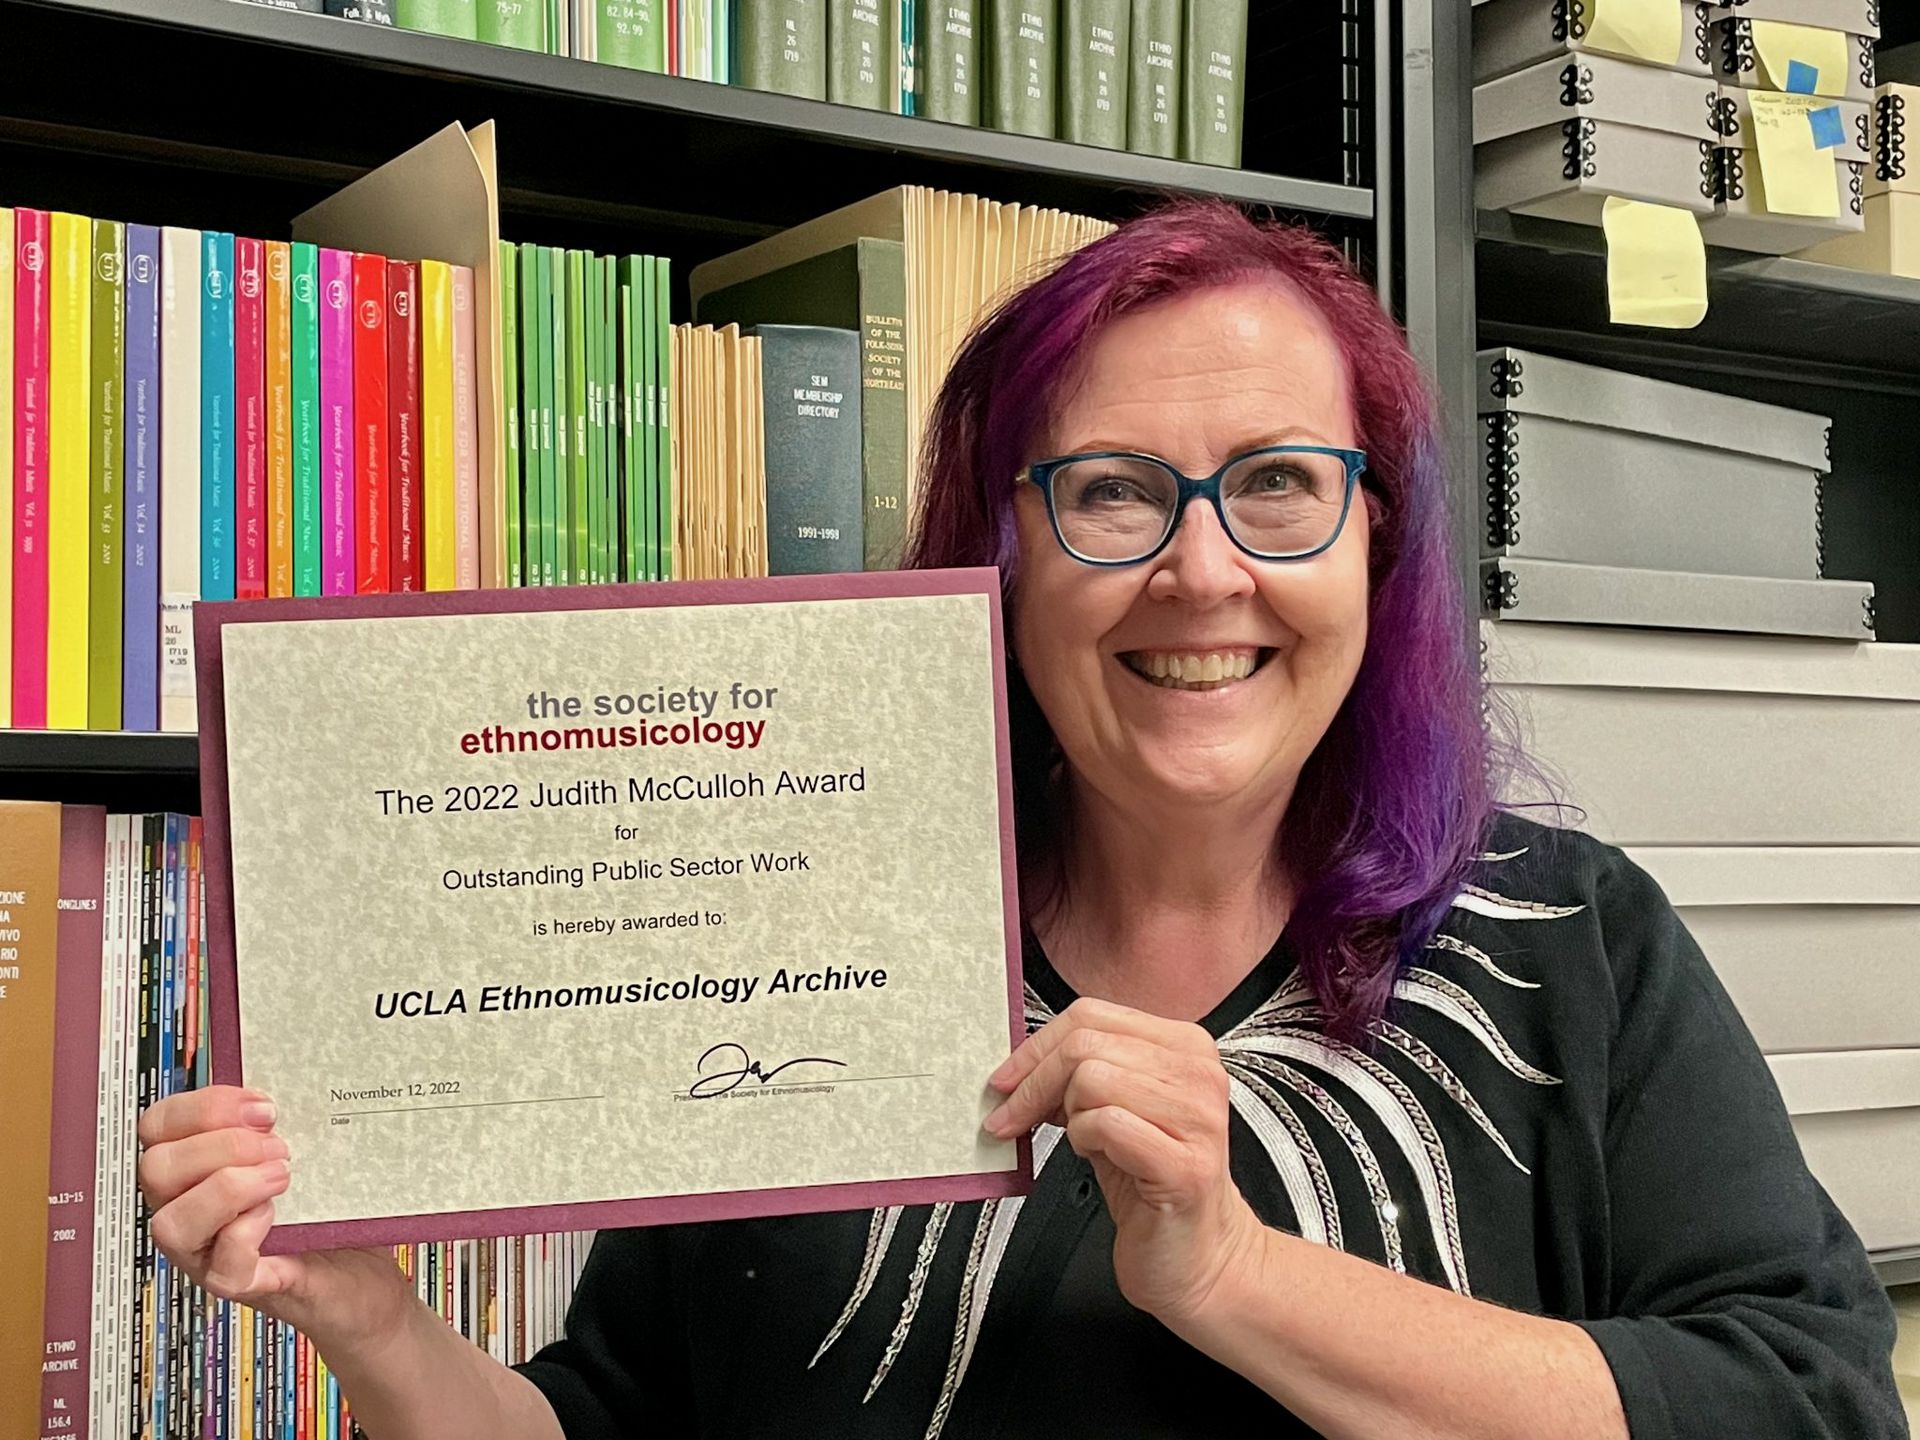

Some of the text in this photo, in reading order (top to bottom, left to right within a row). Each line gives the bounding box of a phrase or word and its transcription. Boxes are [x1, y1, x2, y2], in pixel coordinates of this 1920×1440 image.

[949, 7, 970, 23] ETHNO
[1022, 12, 1043, 28] ETHNO
[1092, 26, 1114, 41] ETHNO
[1150, 41, 1172, 55] ETHNO
[1211, 51, 1232, 66] ETHNO
[866, 315, 903, 327] BULLETIN
[871, 328, 901, 339] OF THE
[868, 353, 901, 365] SOCIETY
[811, 375, 829, 386] SEM
[872, 367, 901, 378] OF THE
[793, 389, 843, 404] MEMBERSHIP
[797, 405, 840, 419] DIRECTORY
[301, 400, 311, 445] Yearbook
[333, 405, 343, 449] Yearbook
[273, 434, 285, 451] for
[400, 412, 409, 456] Yearbook
[103, 428, 113, 468] Traditional
[137, 428, 146, 468] Traditional
[300, 447, 312, 462] for
[332, 451, 343, 467] for
[398, 457, 410, 474] for
[103, 471, 112, 493] Music
[136, 470, 145, 492] Music
[275, 455, 285, 515] Traditional
[247, 486, 256, 507] Music
[302, 465, 312, 521] Traditional
[335, 470, 344, 527] Traditional
[367, 424, 379, 575] Yearbook for Traditional Music
[402, 476, 411, 533] Traditional
[459, 463, 469, 551] TRADITIONAL
[875, 496, 898, 509] 1-12
[276, 519, 285, 549] Music
[302, 522, 311, 552] Music
[335, 528, 343, 558] Music
[402, 533, 410, 562] Music
[165, 625, 182, 634] ML
[527, 683, 778, 719] the society for
[461, 717, 765, 755] ethnomusicology
[375, 767, 865, 815] The 2022 Judith McCulloh Award
[615, 825, 638, 840] for
[443, 851, 810, 890] Outstanding Public Sector Work
[533, 911, 727, 936] is hereby awarded to:
[375, 965, 887, 1019] UCLA Ethnomusicology Archive
[331, 1082, 460, 1102] November 12, 2022
[731, 1085, 835, 1099] Society for Ethnomusicology
[331, 1117, 350, 1126] Date
[53, 1229, 76, 1241] 2002
[46, 1340, 76, 1354] ETHNO
[42, 1359, 79, 1373] ARCHIVE
[54, 1398, 67, 1409] ML
